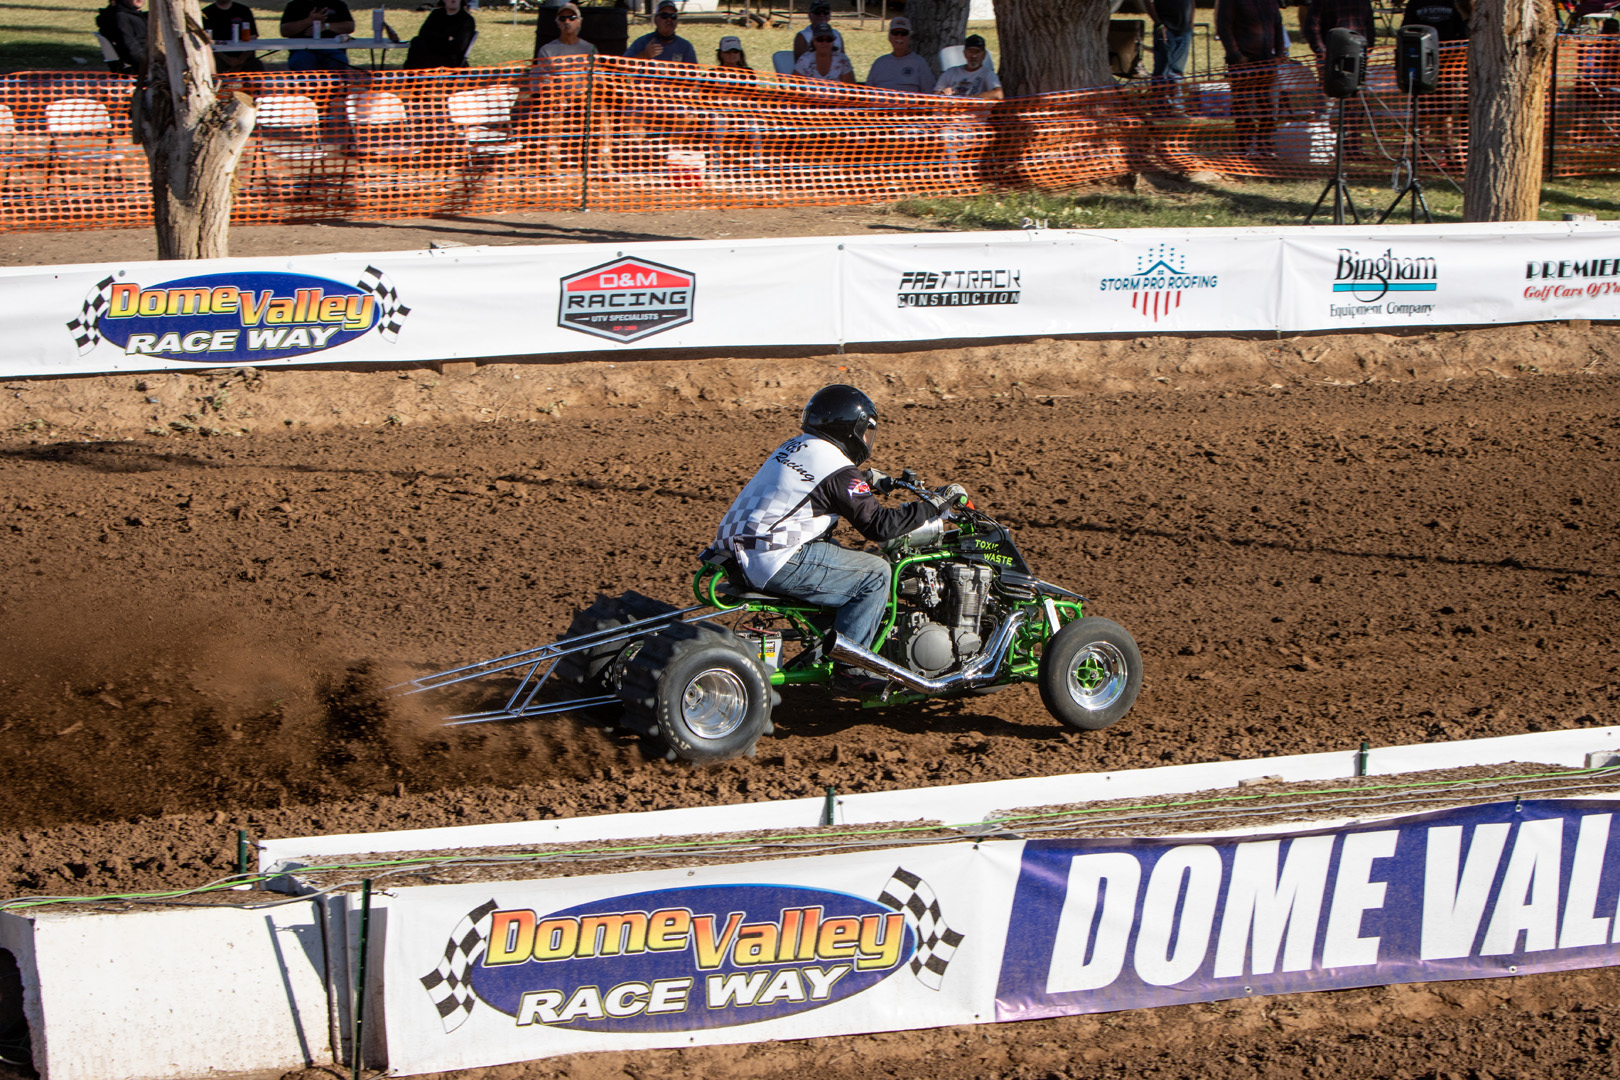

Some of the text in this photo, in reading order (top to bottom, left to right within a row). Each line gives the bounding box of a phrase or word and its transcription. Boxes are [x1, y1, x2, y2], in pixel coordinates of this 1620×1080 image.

[600, 272, 657, 288] D&M
[1100, 275, 1218, 291] STORM PRO ROOFING
[1334, 248, 1438, 303] Bingham
[568, 291, 687, 309] RACING
[898, 292, 1019, 307] CONSTRUCTION
[1523, 285, 1555, 301] Golf
[1554, 285, 1583, 298] Cars
[1586, 282, 1606, 298] Of
[106, 283, 374, 330] Dome Valley
[1330, 302, 1436, 319] Equipment Company
[608, 313, 659, 321] SPECIALISTS
[125, 326, 341, 356] RACE WAY
[772, 452, 815, 483] Racing
[984, 553, 1013, 567] WASTE
[1045, 813, 1620, 994] DOME VAL
[483, 907, 905, 971] Dome Valley
[516, 965, 853, 1028] RACE WAY
